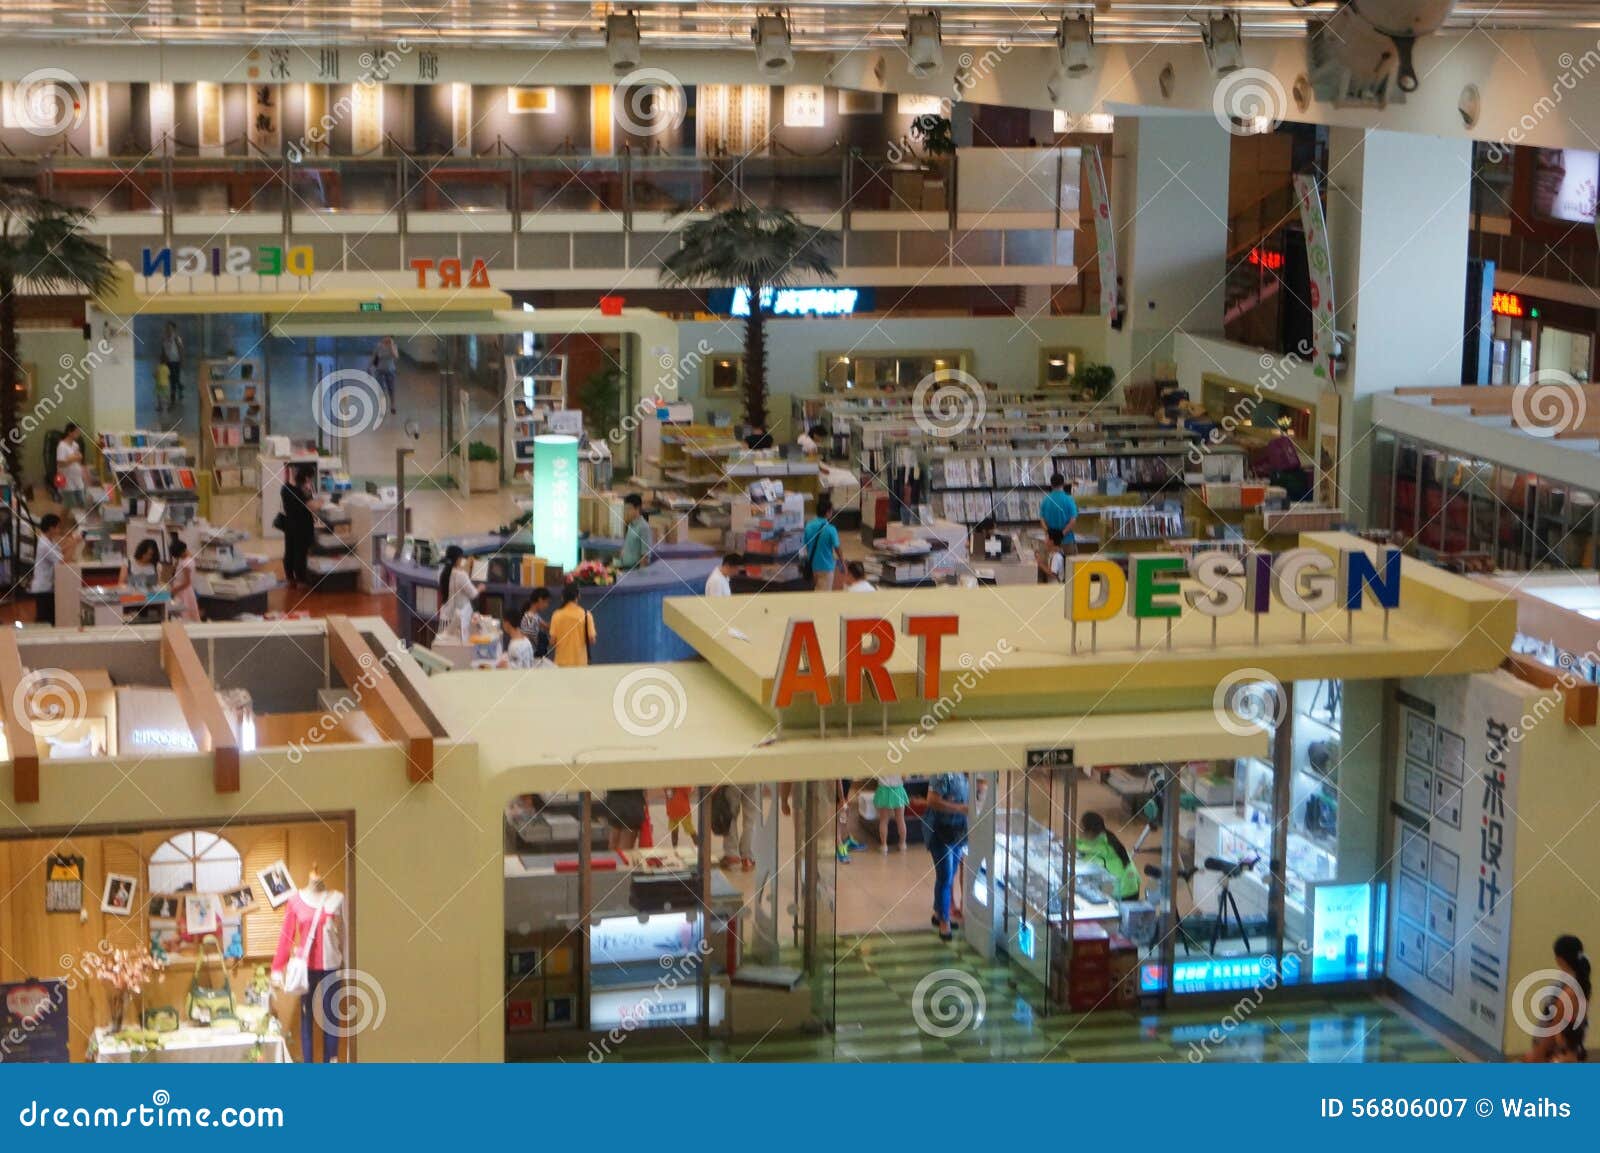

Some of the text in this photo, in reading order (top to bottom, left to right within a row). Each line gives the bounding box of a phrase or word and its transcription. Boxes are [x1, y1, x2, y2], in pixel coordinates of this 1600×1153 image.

[1065, 545, 1401, 622] DESIGN
[772, 614, 959, 707] ART
[1478, 716, 1509, 916] 艺术设计
